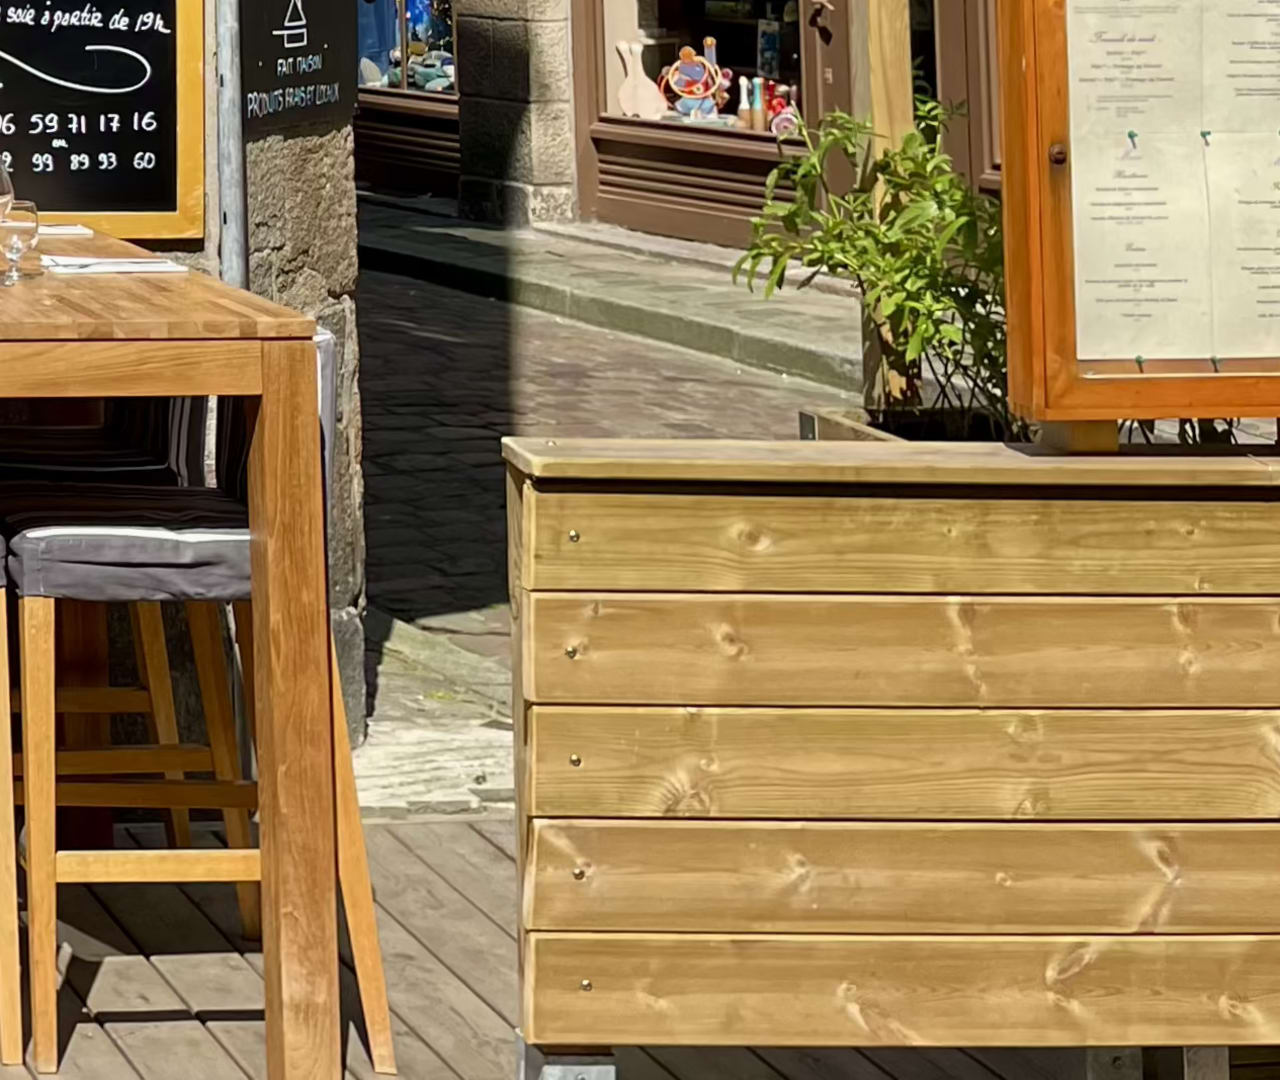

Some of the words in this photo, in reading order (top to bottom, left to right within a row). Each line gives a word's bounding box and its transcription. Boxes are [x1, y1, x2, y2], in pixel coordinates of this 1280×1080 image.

[109, 9, 128, 31] de
[134, 12, 171, 34] 19h
[29, 113, 58, 134] 59
[67, 115, 87, 134] 71
[99, 113, 121, 133] 17
[133, 111, 157, 131] 16
[31, 154, 53, 171] 99
[69, 154, 90, 170] 89
[98, 152, 117, 169] 93
[133, 152, 155, 169] 60
